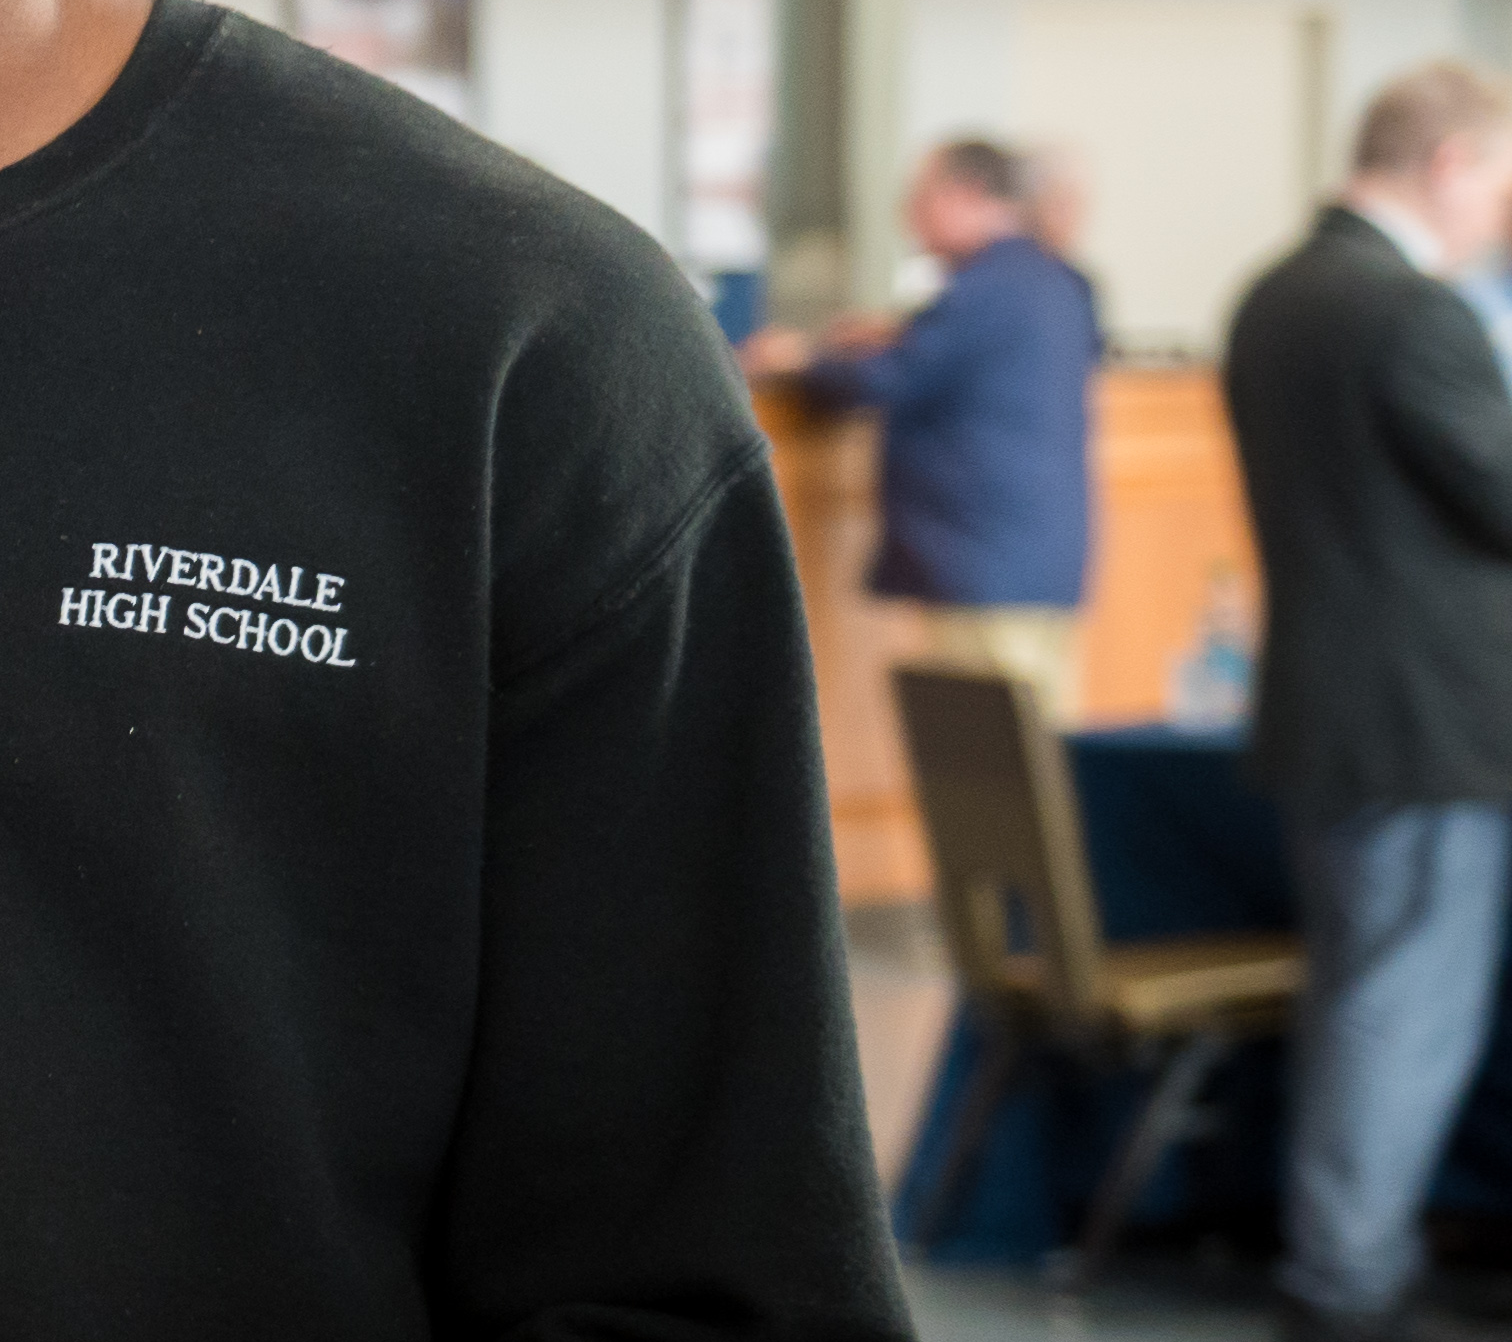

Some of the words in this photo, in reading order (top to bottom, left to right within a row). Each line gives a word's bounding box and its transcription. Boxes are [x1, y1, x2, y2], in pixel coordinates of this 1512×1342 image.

[89, 543, 345, 612] RIVERDALE
[58, 587, 171, 633] HIGH
[183, 602, 356, 667] SCHOOL
